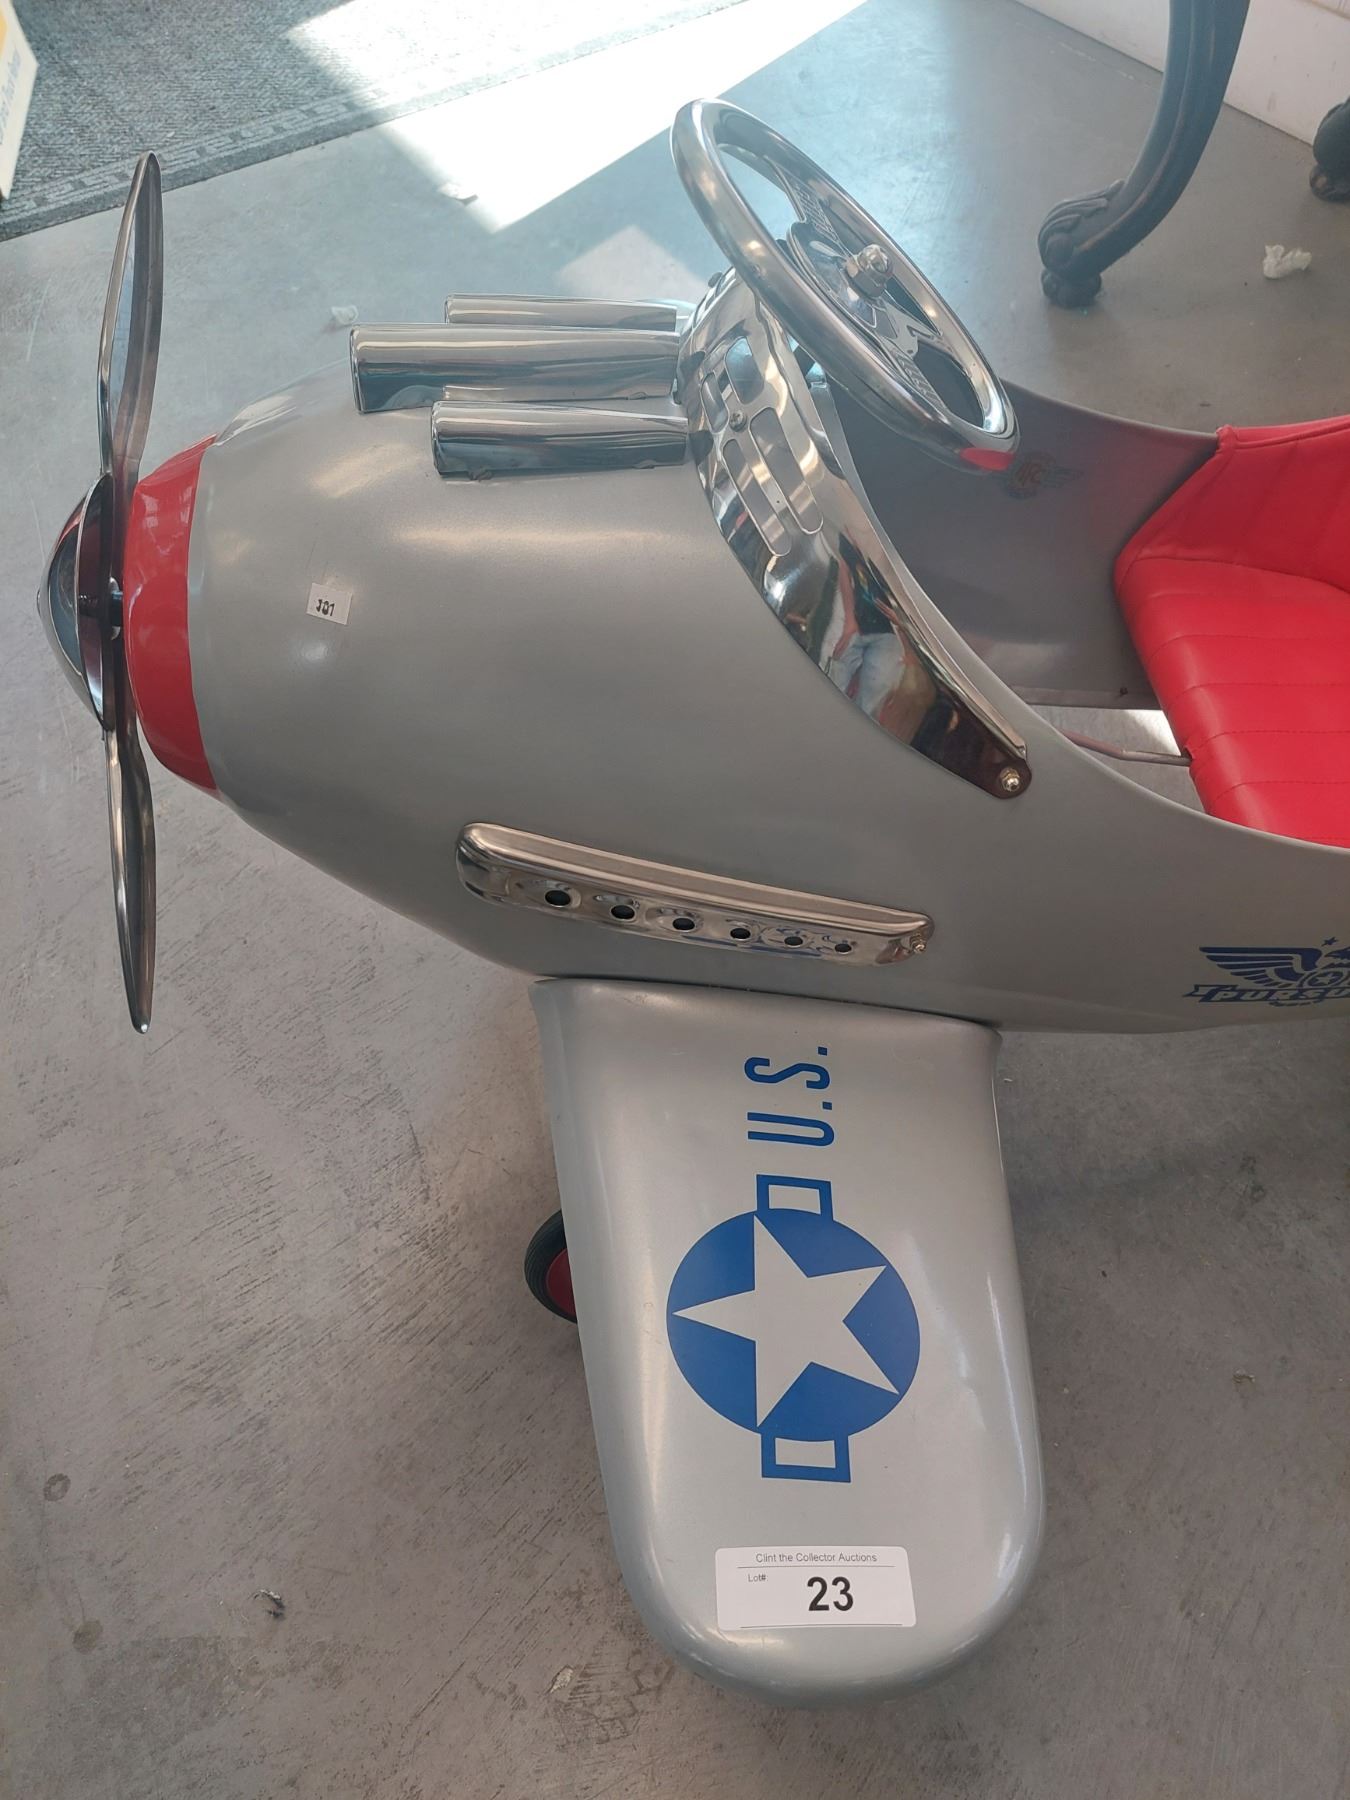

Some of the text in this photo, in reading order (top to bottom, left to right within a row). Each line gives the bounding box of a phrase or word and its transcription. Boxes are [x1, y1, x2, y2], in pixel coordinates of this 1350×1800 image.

[744, 1046, 834, 1147] U.S.
[756, 1552, 878, 1563] Clint the Collector Auctions
[807, 1576, 854, 1612] 23
